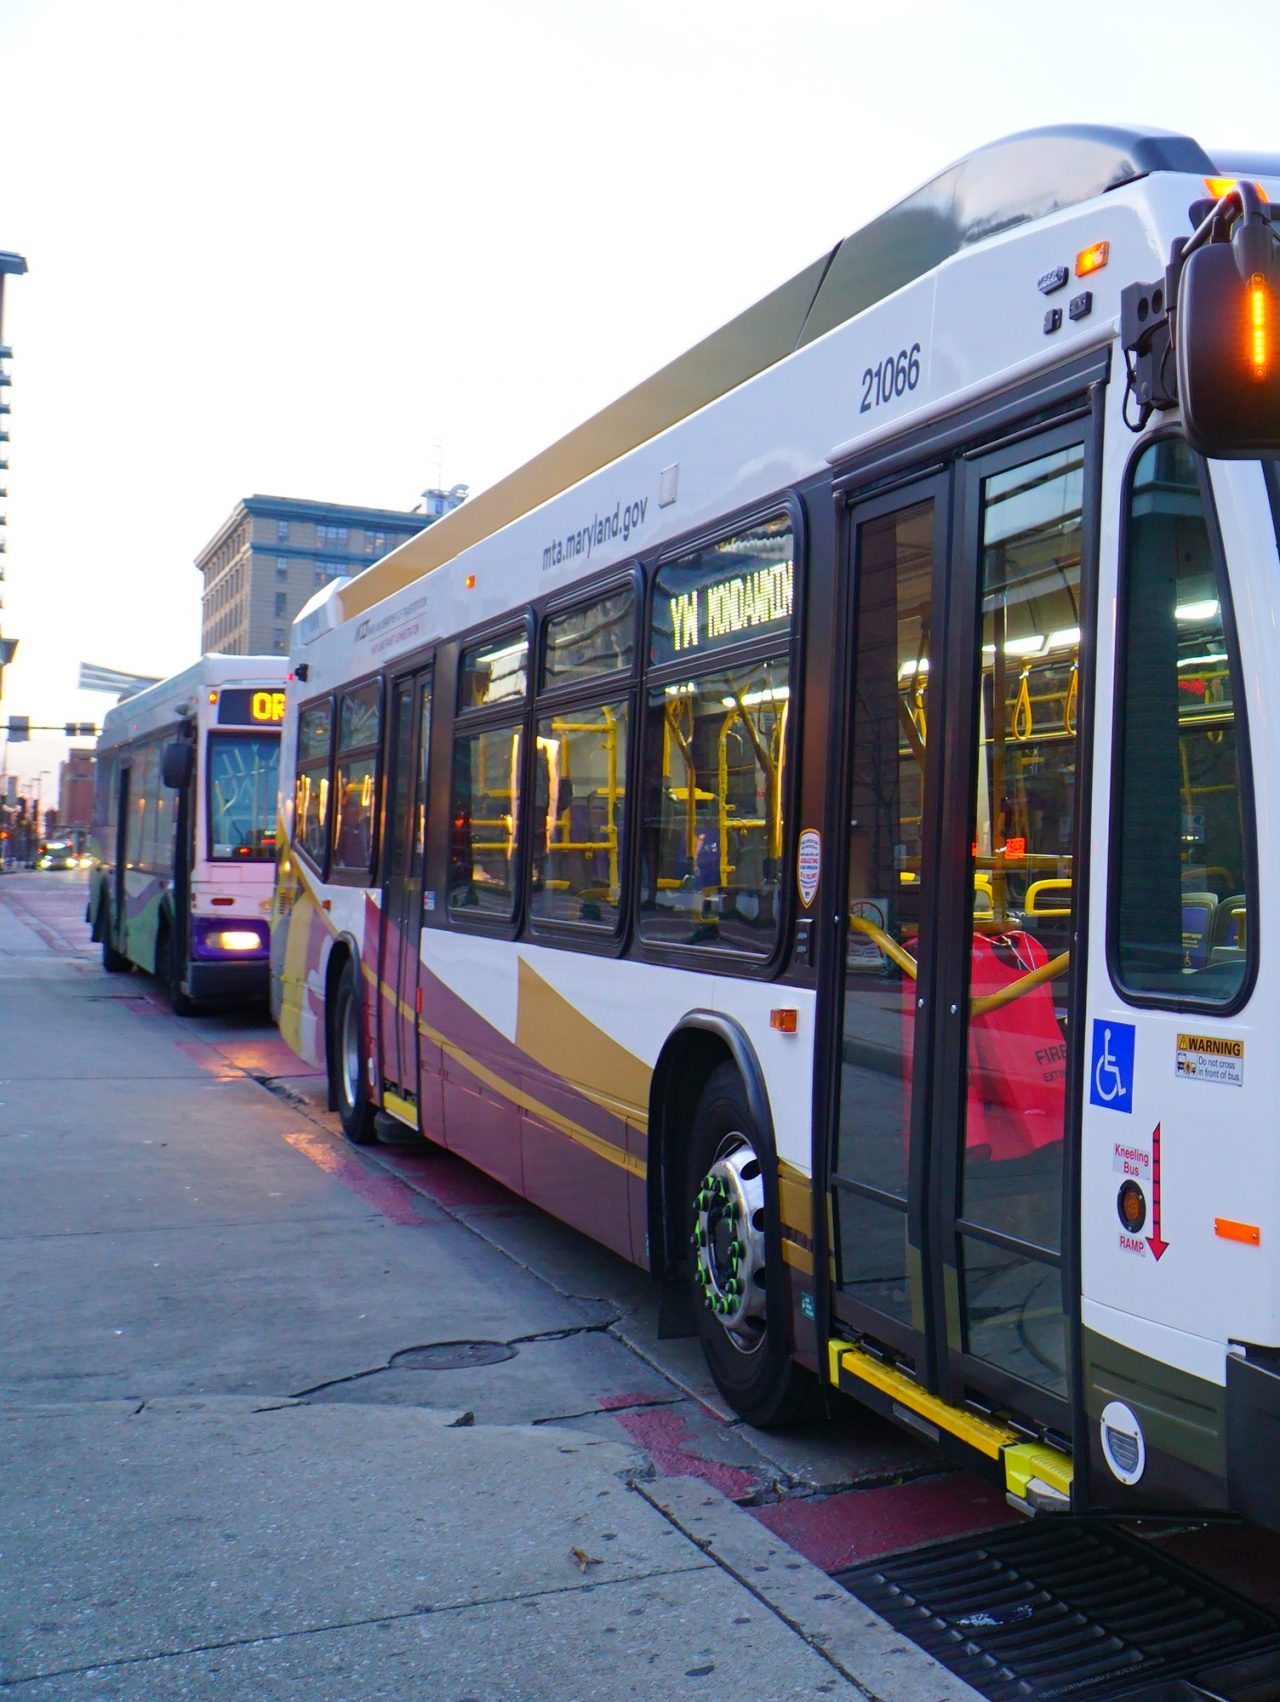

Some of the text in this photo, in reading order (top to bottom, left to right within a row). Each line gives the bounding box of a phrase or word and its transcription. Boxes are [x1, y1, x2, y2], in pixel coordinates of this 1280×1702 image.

[860, 342, 921, 414] 21066
[543, 497, 648, 571] mta.maryland.gov
[670, 590, 698, 650] YW
[1189, 1037, 1241, 1057] WARNING
[1199, 1055, 1235, 1070] Do not cross
[1205, 1067, 1219, 1078] front
[1220, 1070, 1227, 1079] of
[1115, 1144, 1149, 1167] Kneeling
[1123, 1161, 1139, 1176] Bus
[1120, 1235, 1144, 1253] RAMP
